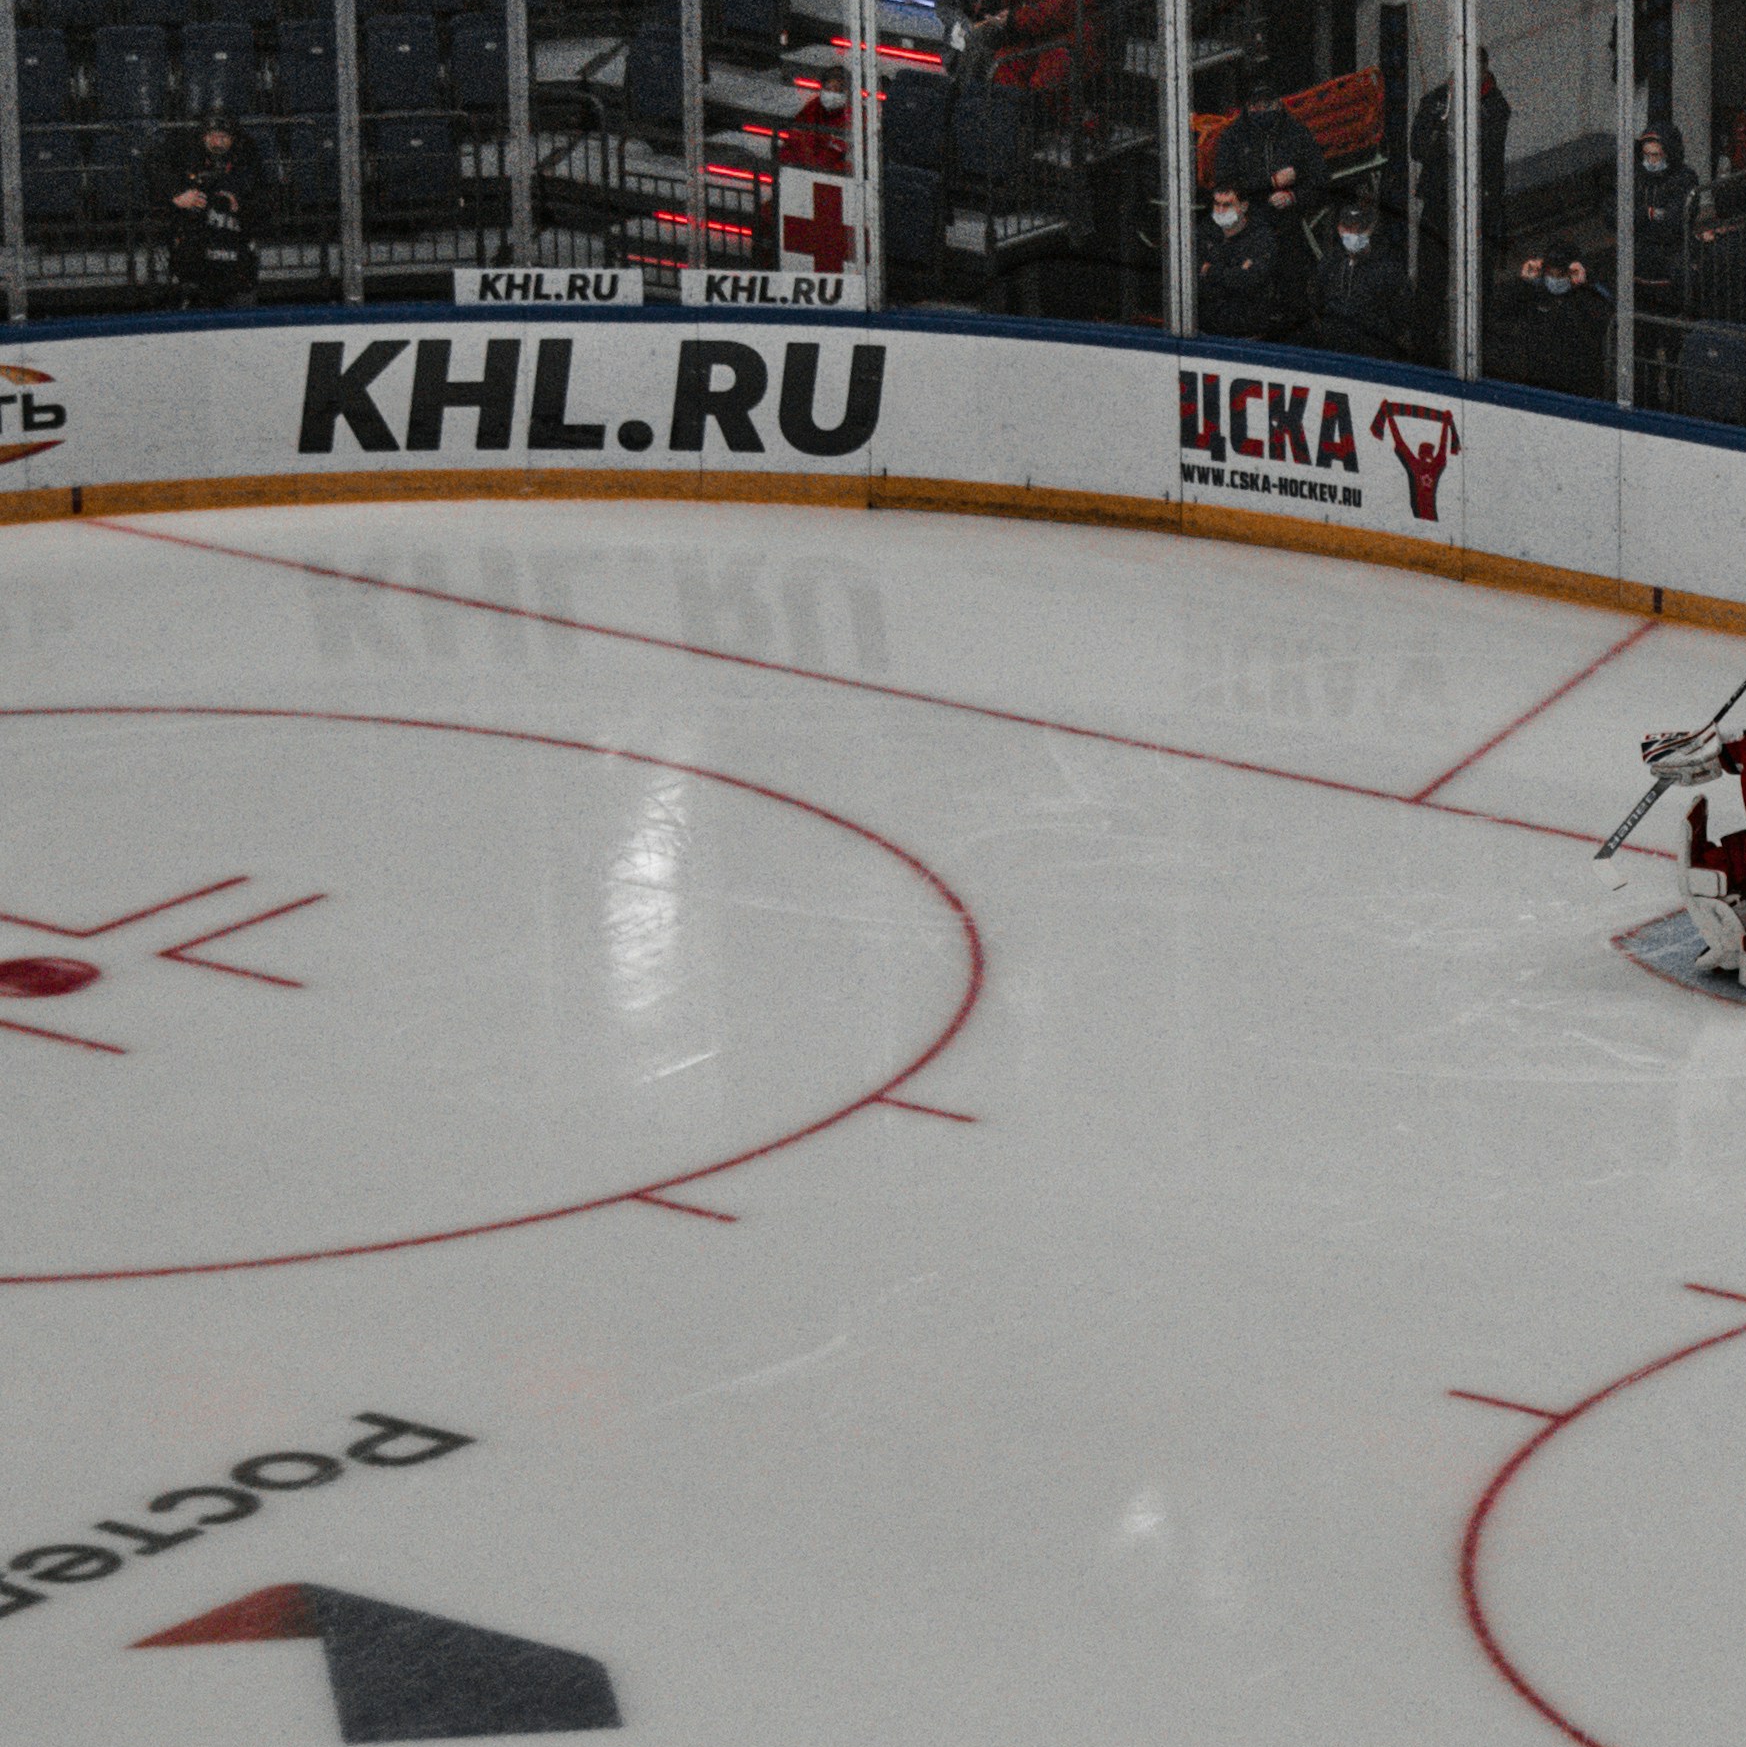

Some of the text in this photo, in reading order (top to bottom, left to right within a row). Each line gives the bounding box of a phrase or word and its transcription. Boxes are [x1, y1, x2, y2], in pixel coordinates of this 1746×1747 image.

[479, 273, 619, 301] KHL.RU
[705, 275, 843, 305] KHL.RU
[298, 338, 887, 457] KHL.RU
[1179, 370, 1359, 473] ЦСКА
[1181, 462, 1362, 508] WWW.CSKA-HOCKEY.RU
